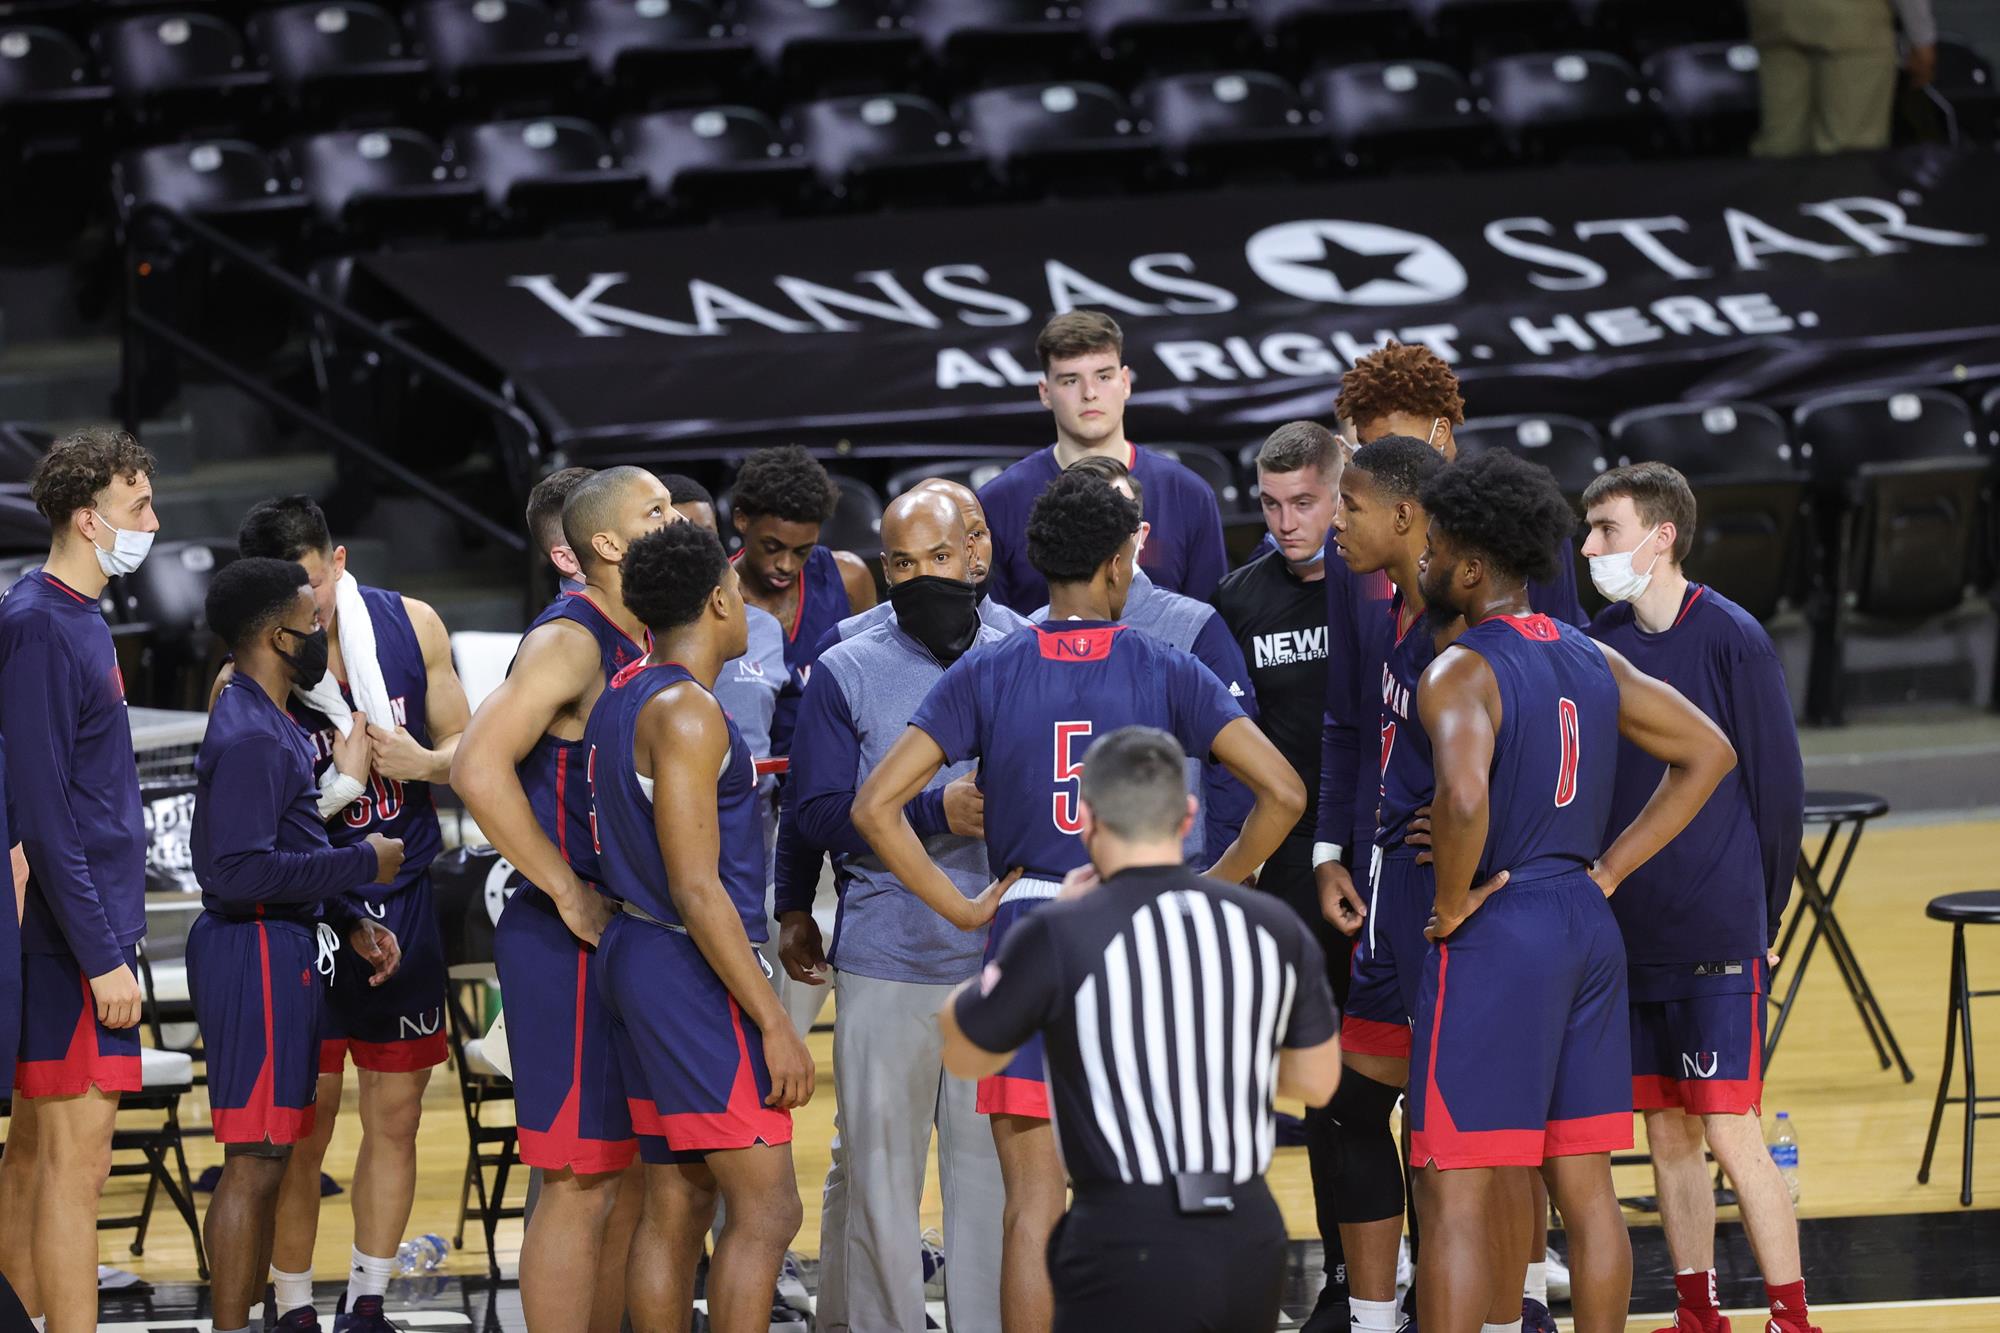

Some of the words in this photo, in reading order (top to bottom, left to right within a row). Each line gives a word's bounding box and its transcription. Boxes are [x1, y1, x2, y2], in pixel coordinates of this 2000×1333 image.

[509, 253, 1237, 337] KANSAS
[1484, 196, 1986, 291] STAR
[1510, 293, 1819, 355] HERE.
[1253, 625, 1328, 668] NEW
[1052, 720, 1092, 835] 5
[400, 1006, 440, 1039] NU
[1682, 1051, 1718, 1078] NU
